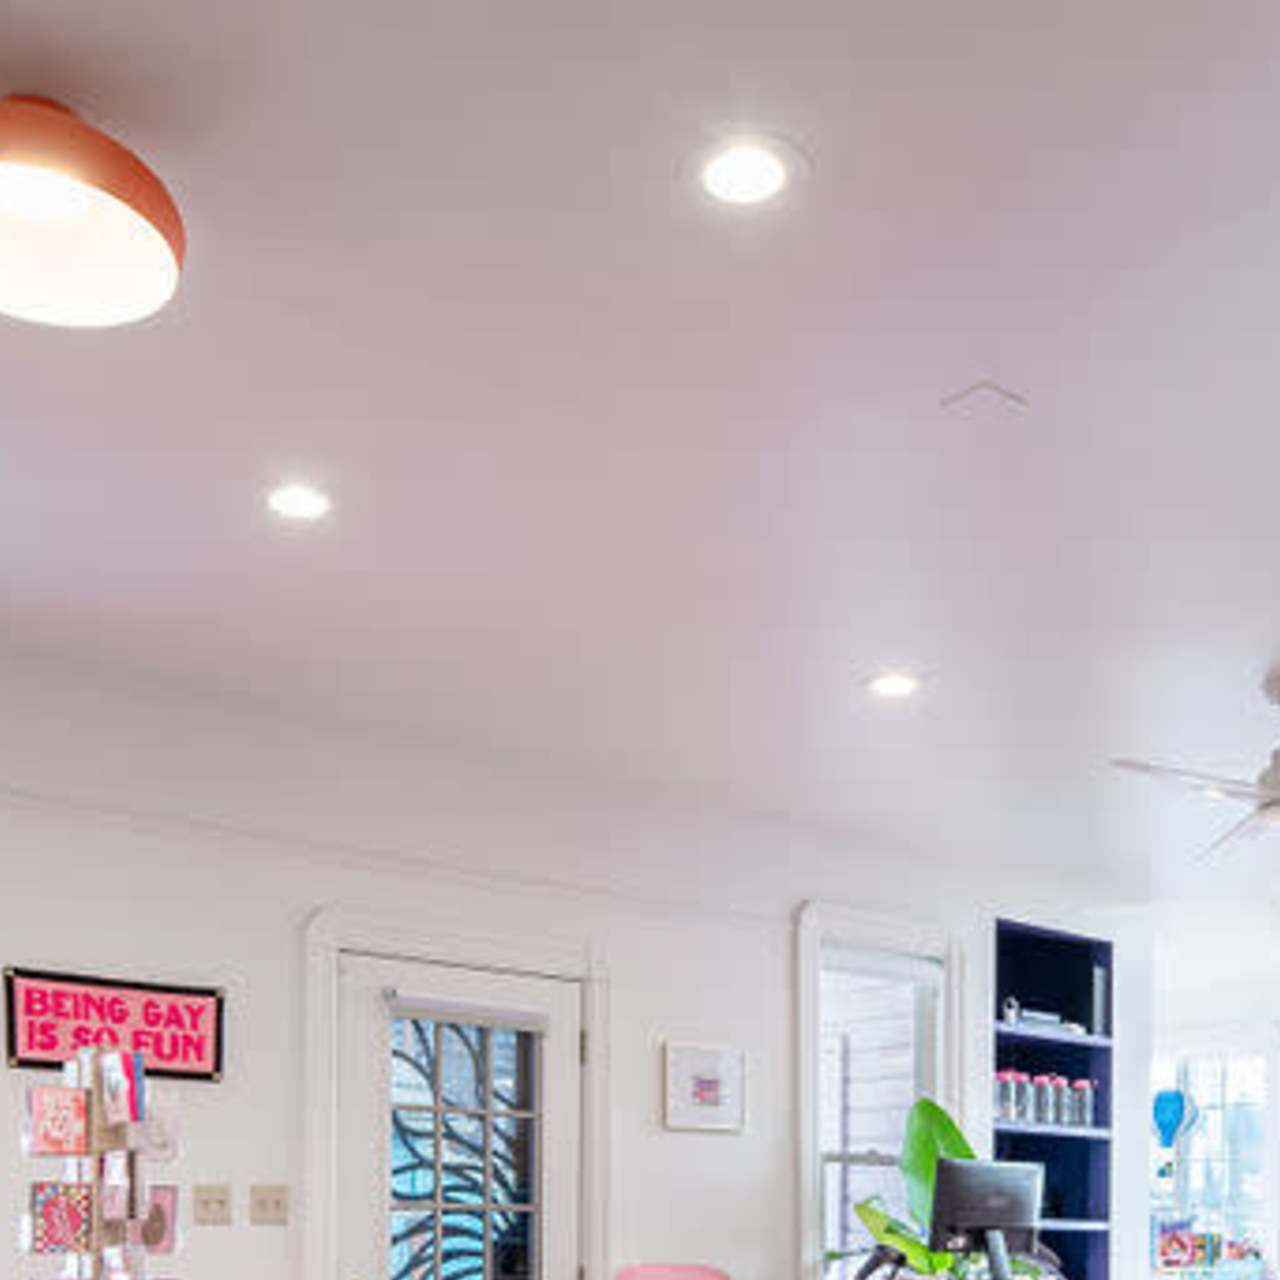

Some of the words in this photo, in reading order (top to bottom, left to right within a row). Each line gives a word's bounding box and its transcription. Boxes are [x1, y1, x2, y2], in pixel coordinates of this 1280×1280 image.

[24, 987, 129, 1024] BEING
[142, 999, 206, 1031] GAY
[27, 1020, 58, 1051] IS
[73, 1025, 119, 1051] SO
[132, 1030, 206, 1062] FUN
